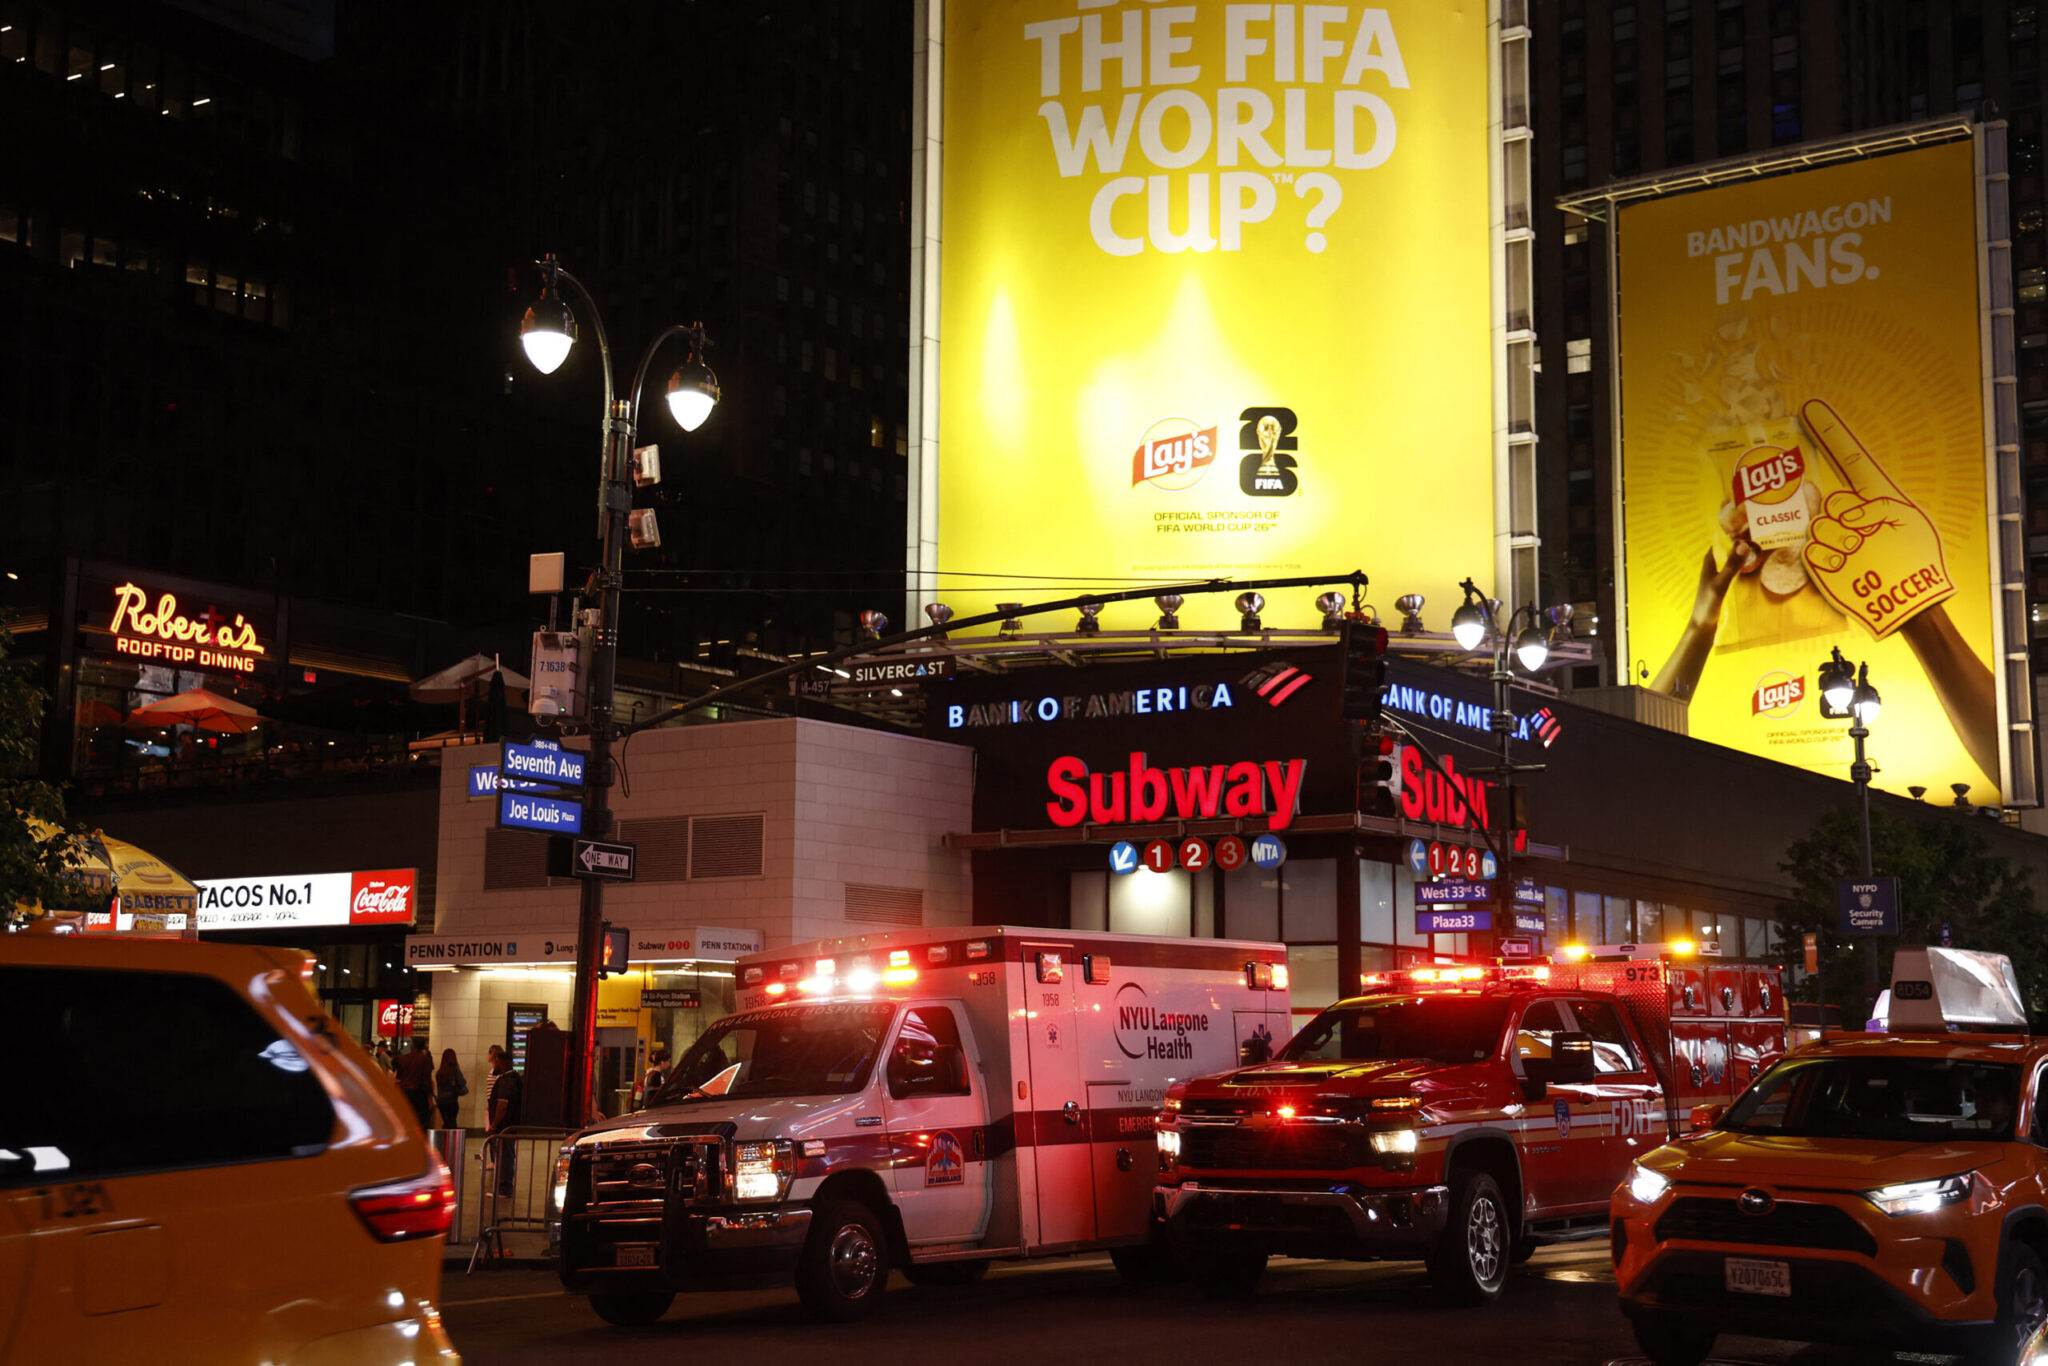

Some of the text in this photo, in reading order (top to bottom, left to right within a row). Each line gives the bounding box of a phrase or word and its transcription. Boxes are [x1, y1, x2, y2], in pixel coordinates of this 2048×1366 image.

[1024, 4, 1411, 97] THE FIFA
[1038, 88, 1397, 178] WORLD
[1687, 196, 1892, 258] BANDWAGON
[1715, 232, 1880, 304] FANS.
[1144, 431, 1212, 478] Lay's
[1255, 478, 1283, 490] FIFA
[1740, 453, 1800, 498] Lay's
[1154, 511, 1280, 521] OFFICIAL SPONSOR OF
[1157, 524, 1181, 533] FIFA
[1184, 523, 1225, 532] WORLD
[1227, 523, 1251, 532] CUP
[1756, 509, 1802, 526] CLASSIC
[1852, 570, 1882, 598] GO
[1866, 564, 1944, 622] SOCCER!
[109, 582, 265, 655] Roberta's
[116, 637, 255, 672] ROOFTOP DINING
[855, 661, 945, 682] SILVERCAST
[1037, 696, 1081, 721] OF
[1085, 683, 1233, 717] AMERICA
[1759, 679, 1802, 711] Lay's
[1430, 694, 1453, 721] OF
[507, 750, 582, 779] Seventh Ave
[1046, 751, 1304, 831] Subway
[509, 799, 575, 823] Joe Louis Plaza
[585, 851, 624, 867] ONE WAY
[1151, 842, 1278, 868] 1 2 3 MTA
[1432, 847, 1439, 870] 1
[1450, 849, 1460, 873] 2
[1468, 852, 1477, 876] 3
[199, 882, 312, 909] TACOS No.1
[354, 885, 411, 914] Coca-Cola
[1421, 884, 1486, 899] West 33rd St
[1852, 884, 1878, 893] NYPD
[124, 894, 195, 910] SABRETT
[1432, 915, 1475, 928] Plaza33
[1849, 909, 1884, 920] Security
[1850, 918, 1883, 927] Camera
[410, 942, 502, 958] PENN STATION
[556, 943, 573, 954] Long
[638, 941, 666, 951] Subway
[701, 941, 721, 950] PENN
[723, 941, 752, 952] STATION
[1626, 967, 1659, 982] 973
[1042, 993, 1060, 1007] 1958
[736, 1008, 800, 1025] LANGONE
[804, 1004, 890, 1017] HOSPITALS
[1120, 1007, 1208, 1037] NYU Langone
[1147, 1037, 1192, 1060] Health
[1118, 1088, 1165, 1102] NYU LANGON
[1611, 1100, 1654, 1137] FDNY
